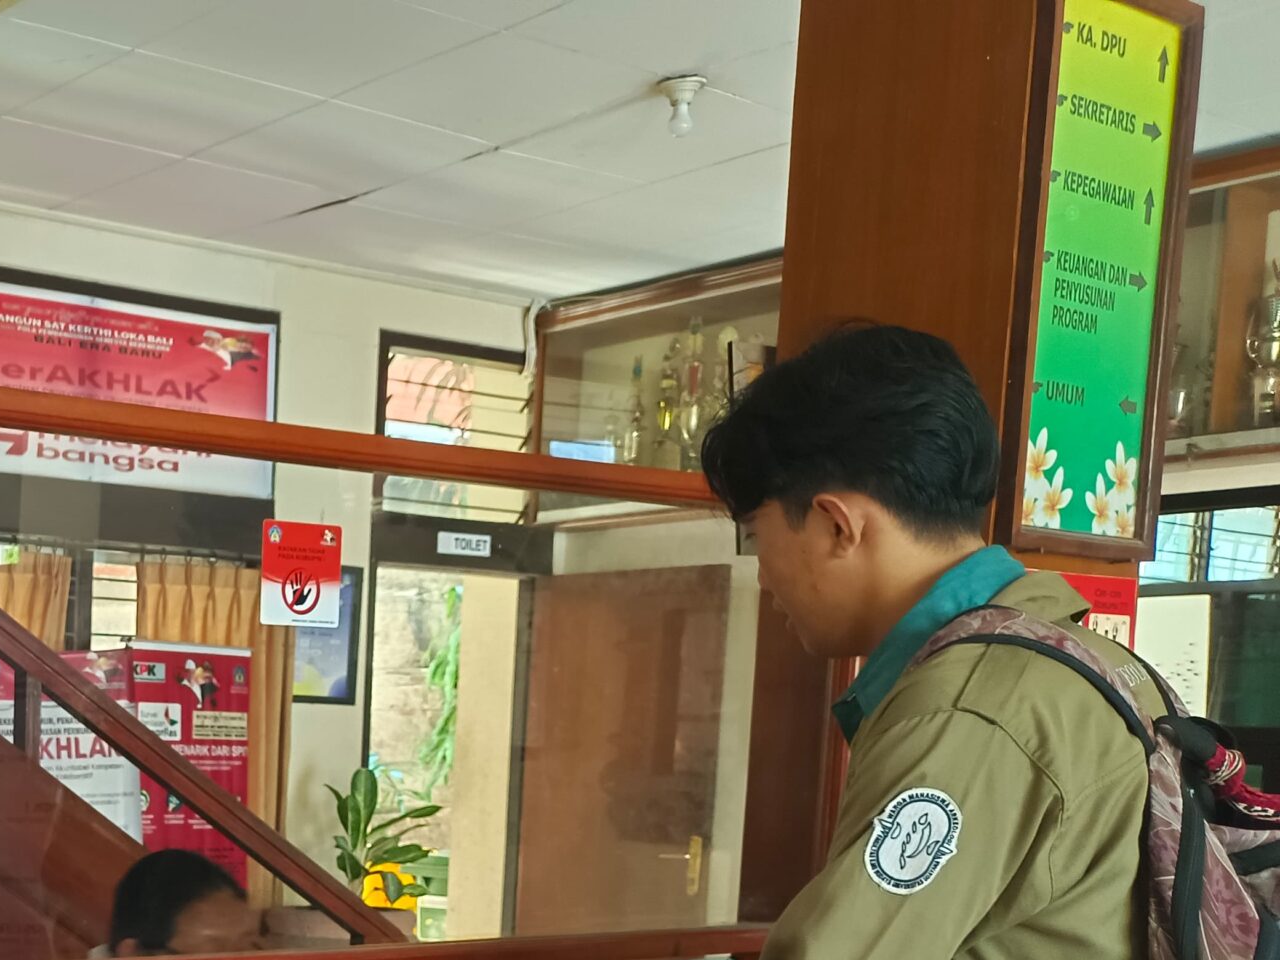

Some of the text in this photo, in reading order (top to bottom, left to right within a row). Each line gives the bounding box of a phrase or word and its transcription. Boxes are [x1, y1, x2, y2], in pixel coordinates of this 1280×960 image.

[1077, 21, 1127, 58] KA. DPU
[1070, 93, 1137, 135] SEKRETARIS
[1063, 170, 1135, 211] KEPEGAWAIAN
[1056, 249, 1128, 288] KEUANGAN DAN
[1054, 277, 1116, 312] PENYUSUNAN
[44, 319, 65, 331] SAT
[69, 322, 112, 339] KERTHI
[114, 329, 145, 341] LOKA
[147, 334, 173, 346] BALI
[1051, 305, 1098, 335] PROGRAM
[34, 334, 162, 360] BALI ERA BARU
[1046, 380, 1085, 407] UMUM
[36, 442, 179, 472] bangsa
[454, 536, 488, 552] TOILET
[887, 798, 908, 819] WARGA
